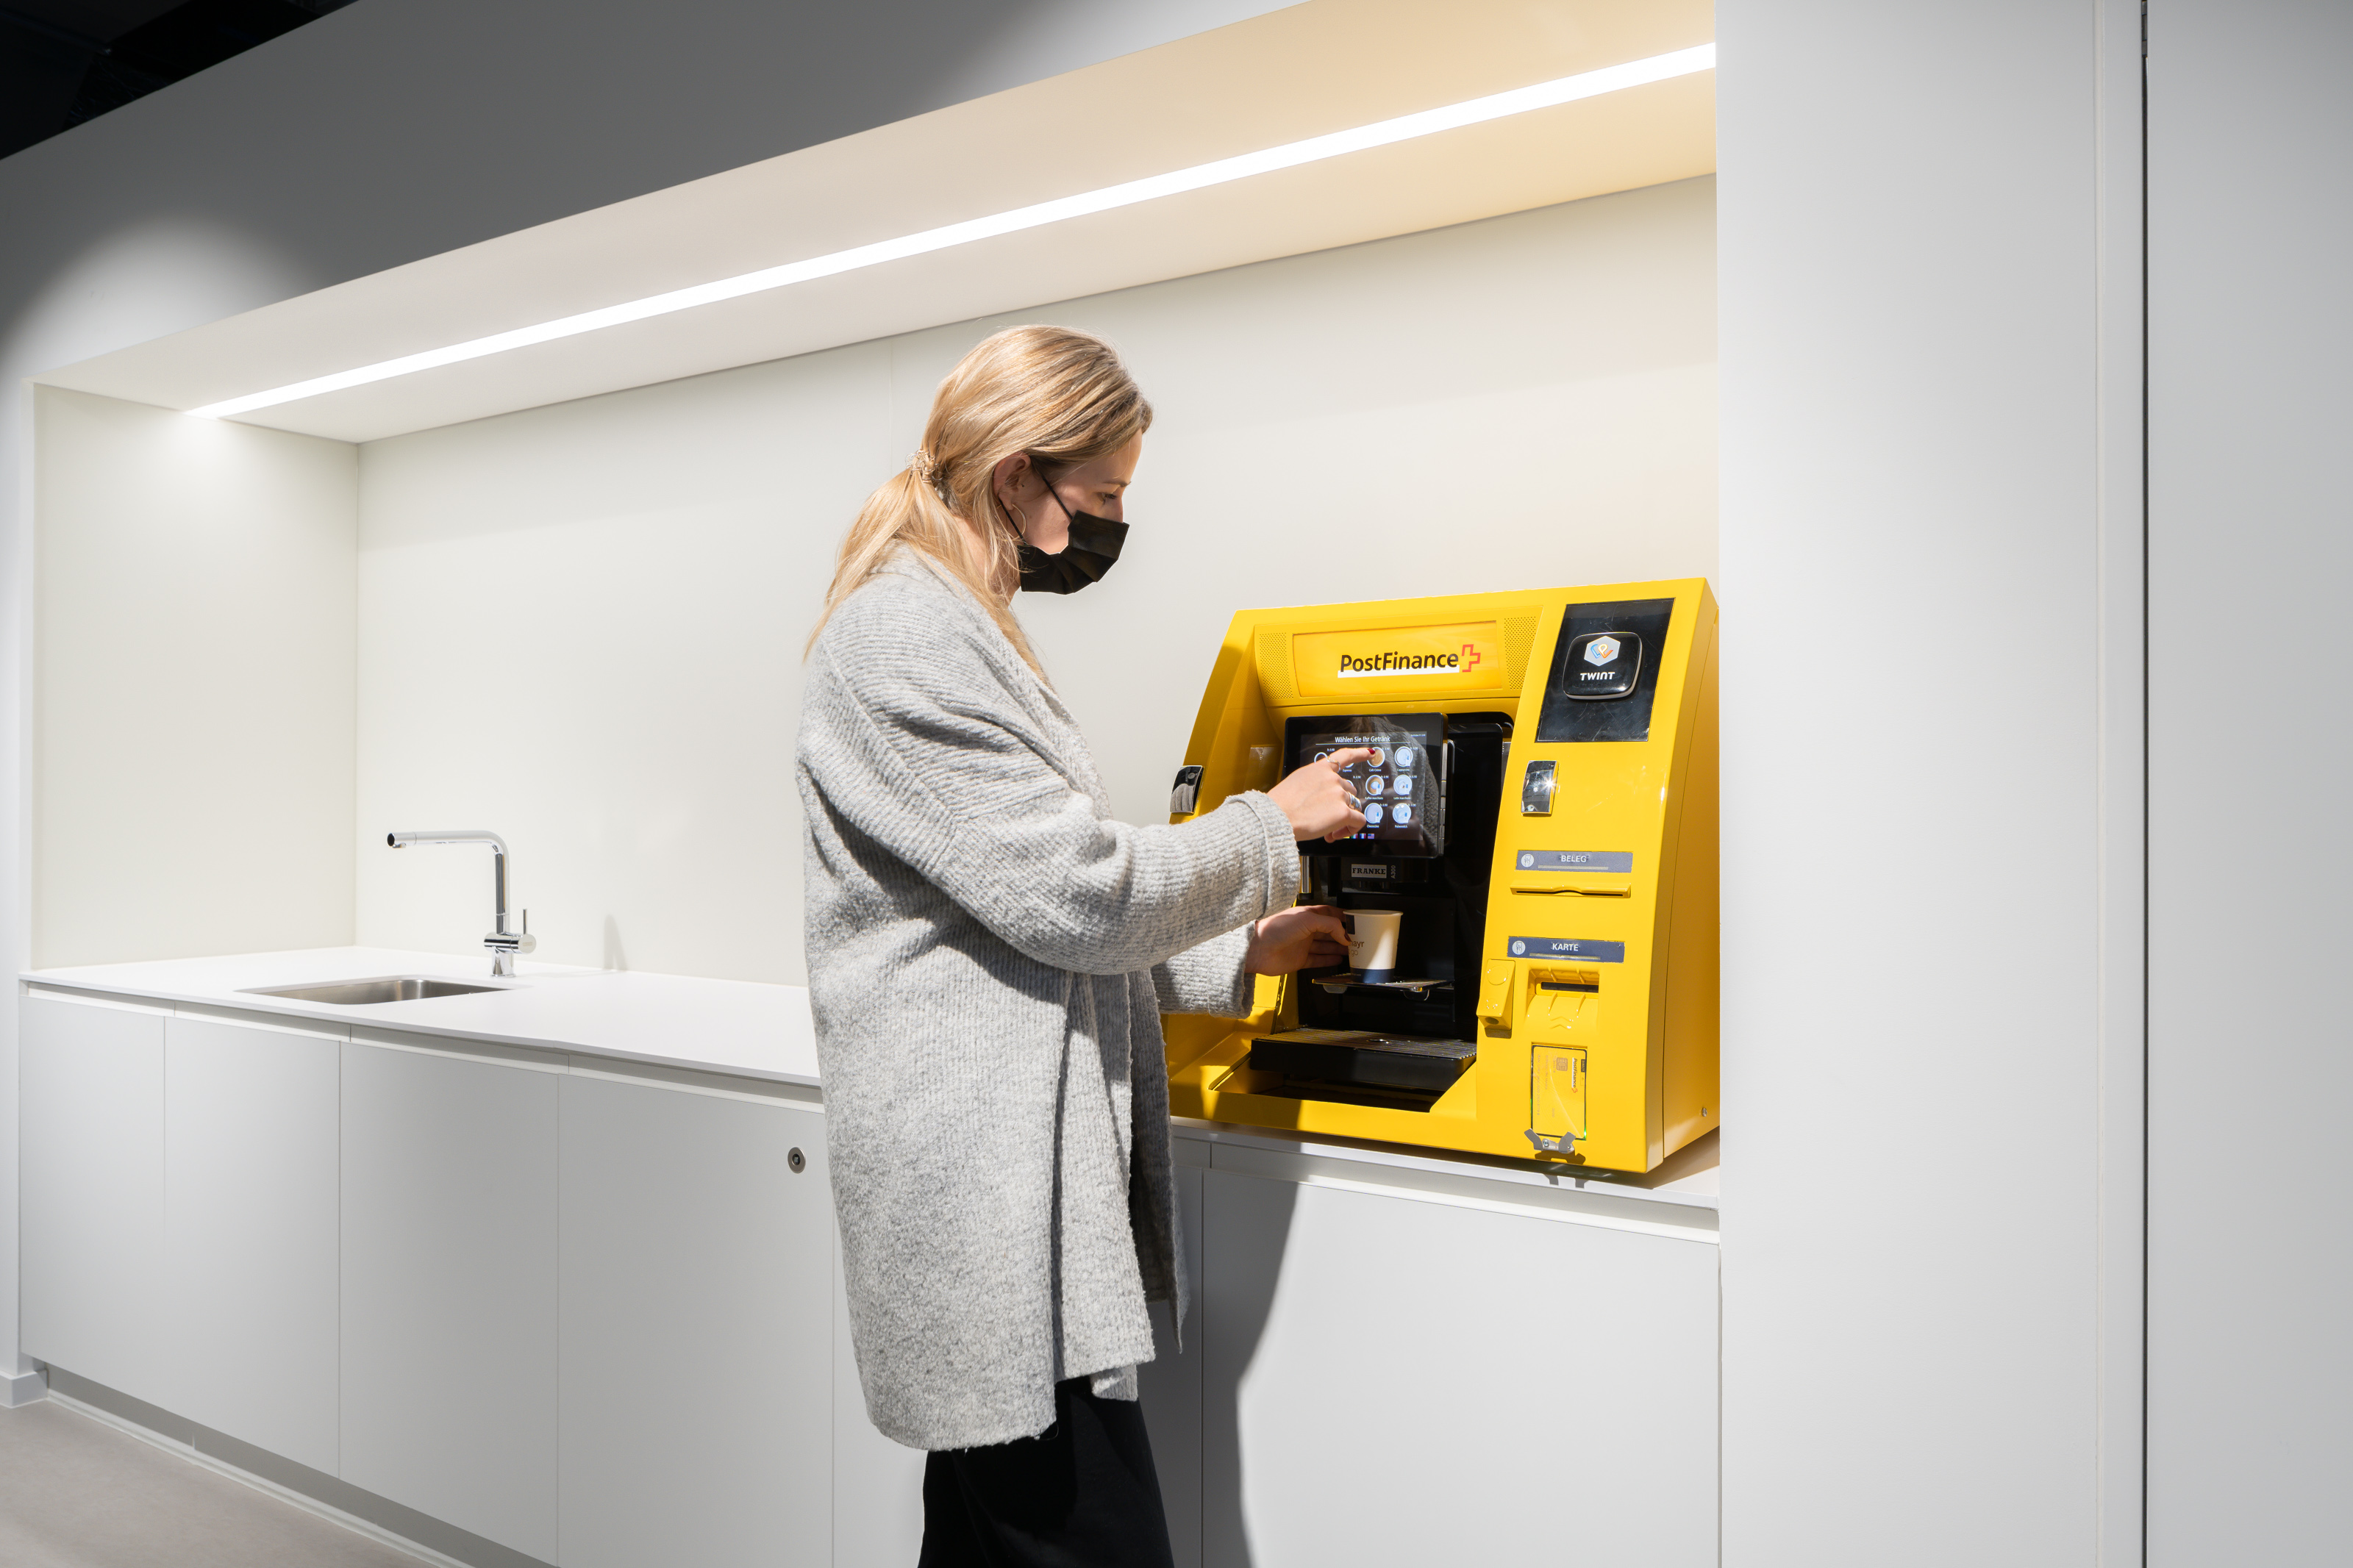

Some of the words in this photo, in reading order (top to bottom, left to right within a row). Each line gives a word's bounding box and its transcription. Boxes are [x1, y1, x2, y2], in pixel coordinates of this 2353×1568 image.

[1340, 651, 1459, 673] PostFinance
[1580, 672, 1615, 681] TWINT
[1560, 855, 1587, 863] BELEG
[1552, 943, 1579, 951] KARTE
